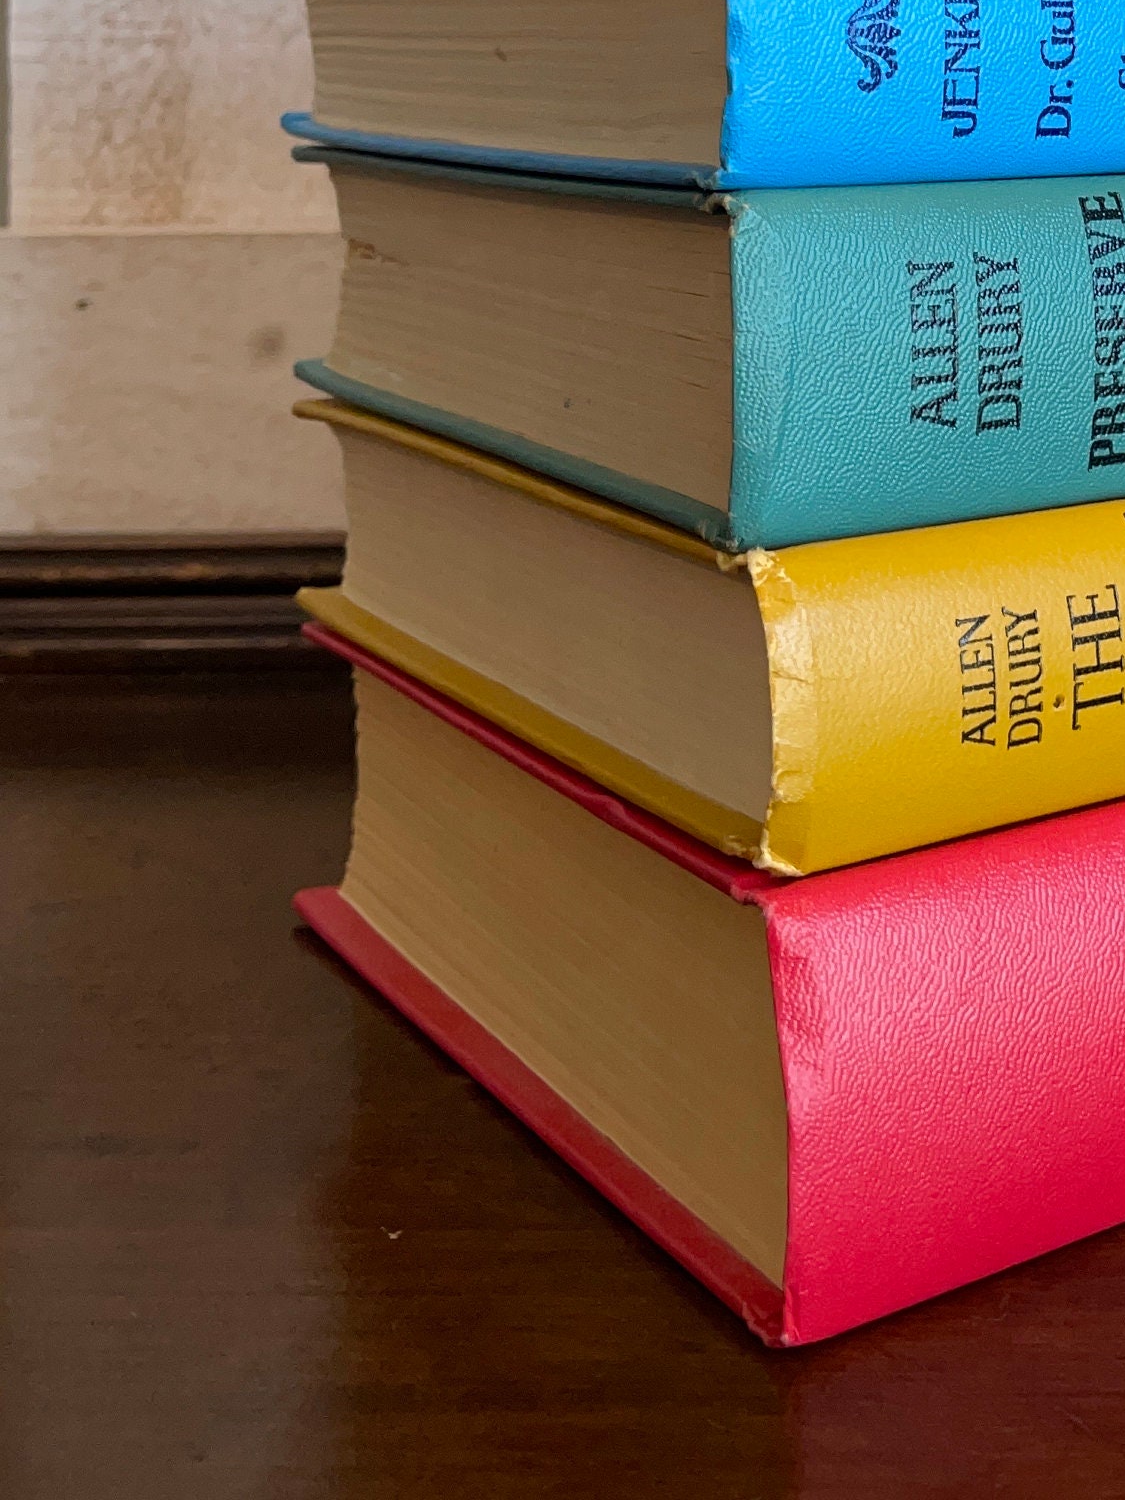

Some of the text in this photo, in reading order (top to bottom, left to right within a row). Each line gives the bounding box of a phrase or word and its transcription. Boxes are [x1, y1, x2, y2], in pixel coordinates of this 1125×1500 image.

[1035, 79, 1075, 140] Dr.
[905, 260, 960, 429] ALLEN
[972, 251, 1024, 436] DRURY
[954, 613, 997, 747] ALLEN
[1001, 606, 1043, 750] DRURY
[1066, 583, 1125, 731] THE
